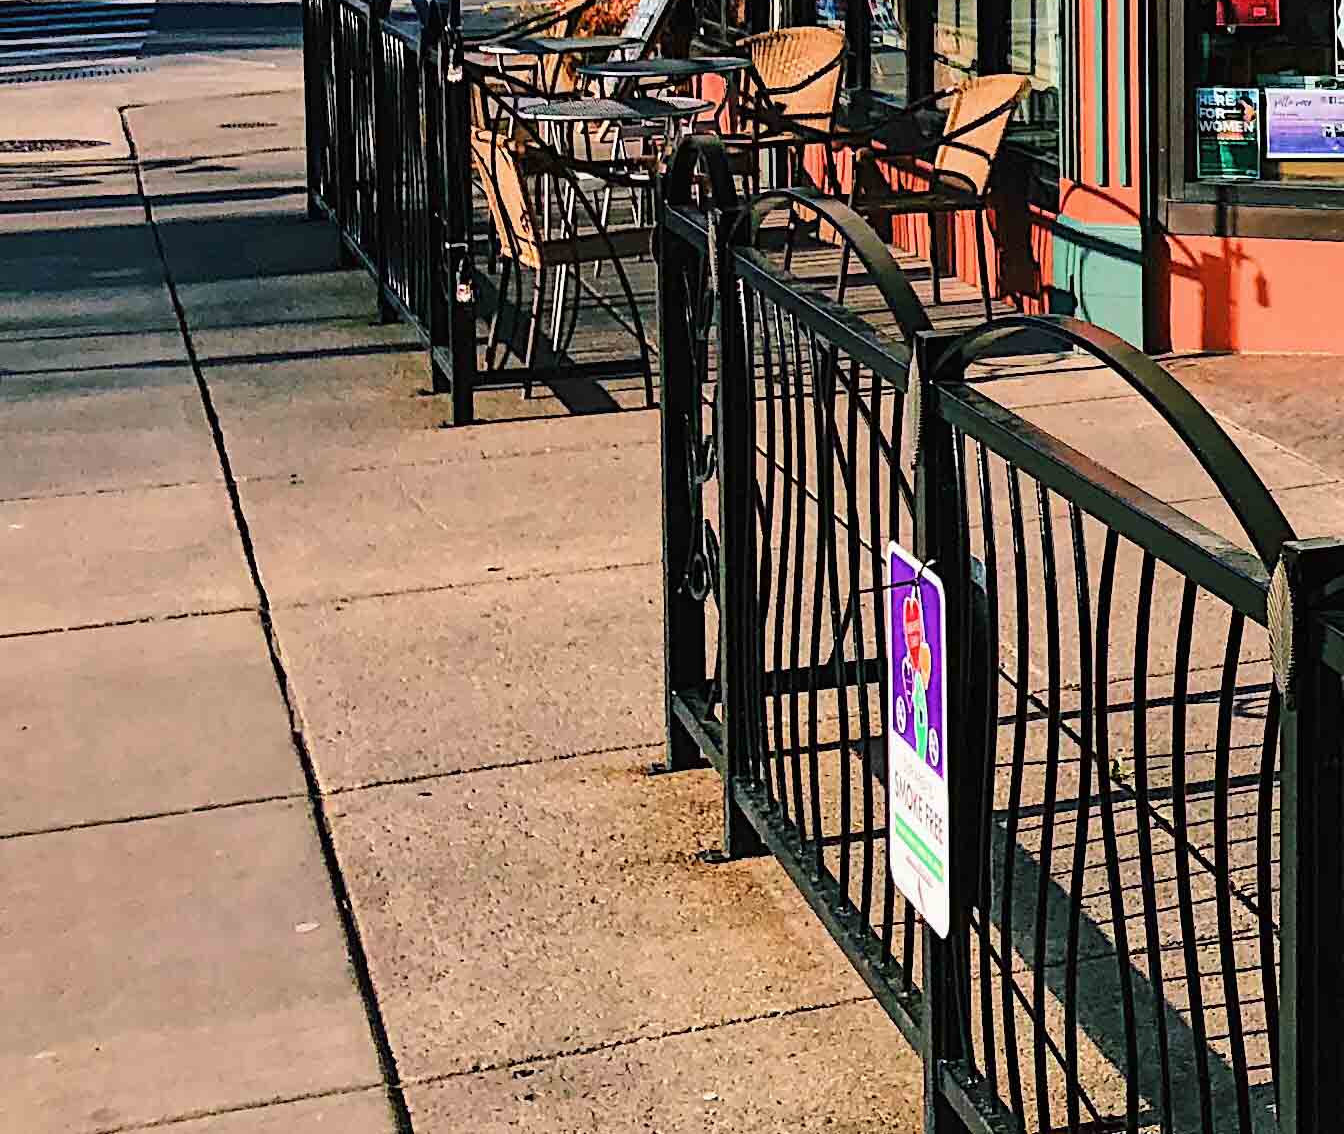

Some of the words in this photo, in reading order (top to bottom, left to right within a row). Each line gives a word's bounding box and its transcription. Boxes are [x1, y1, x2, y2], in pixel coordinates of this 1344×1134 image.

[1200, 94, 1236, 107] HERE
[1200, 108, 1225, 119] FOR
[1200, 120, 1254, 133] WOMEN
[895, 769, 923, 823] SMOKE
[925, 802, 943, 846] FREE
